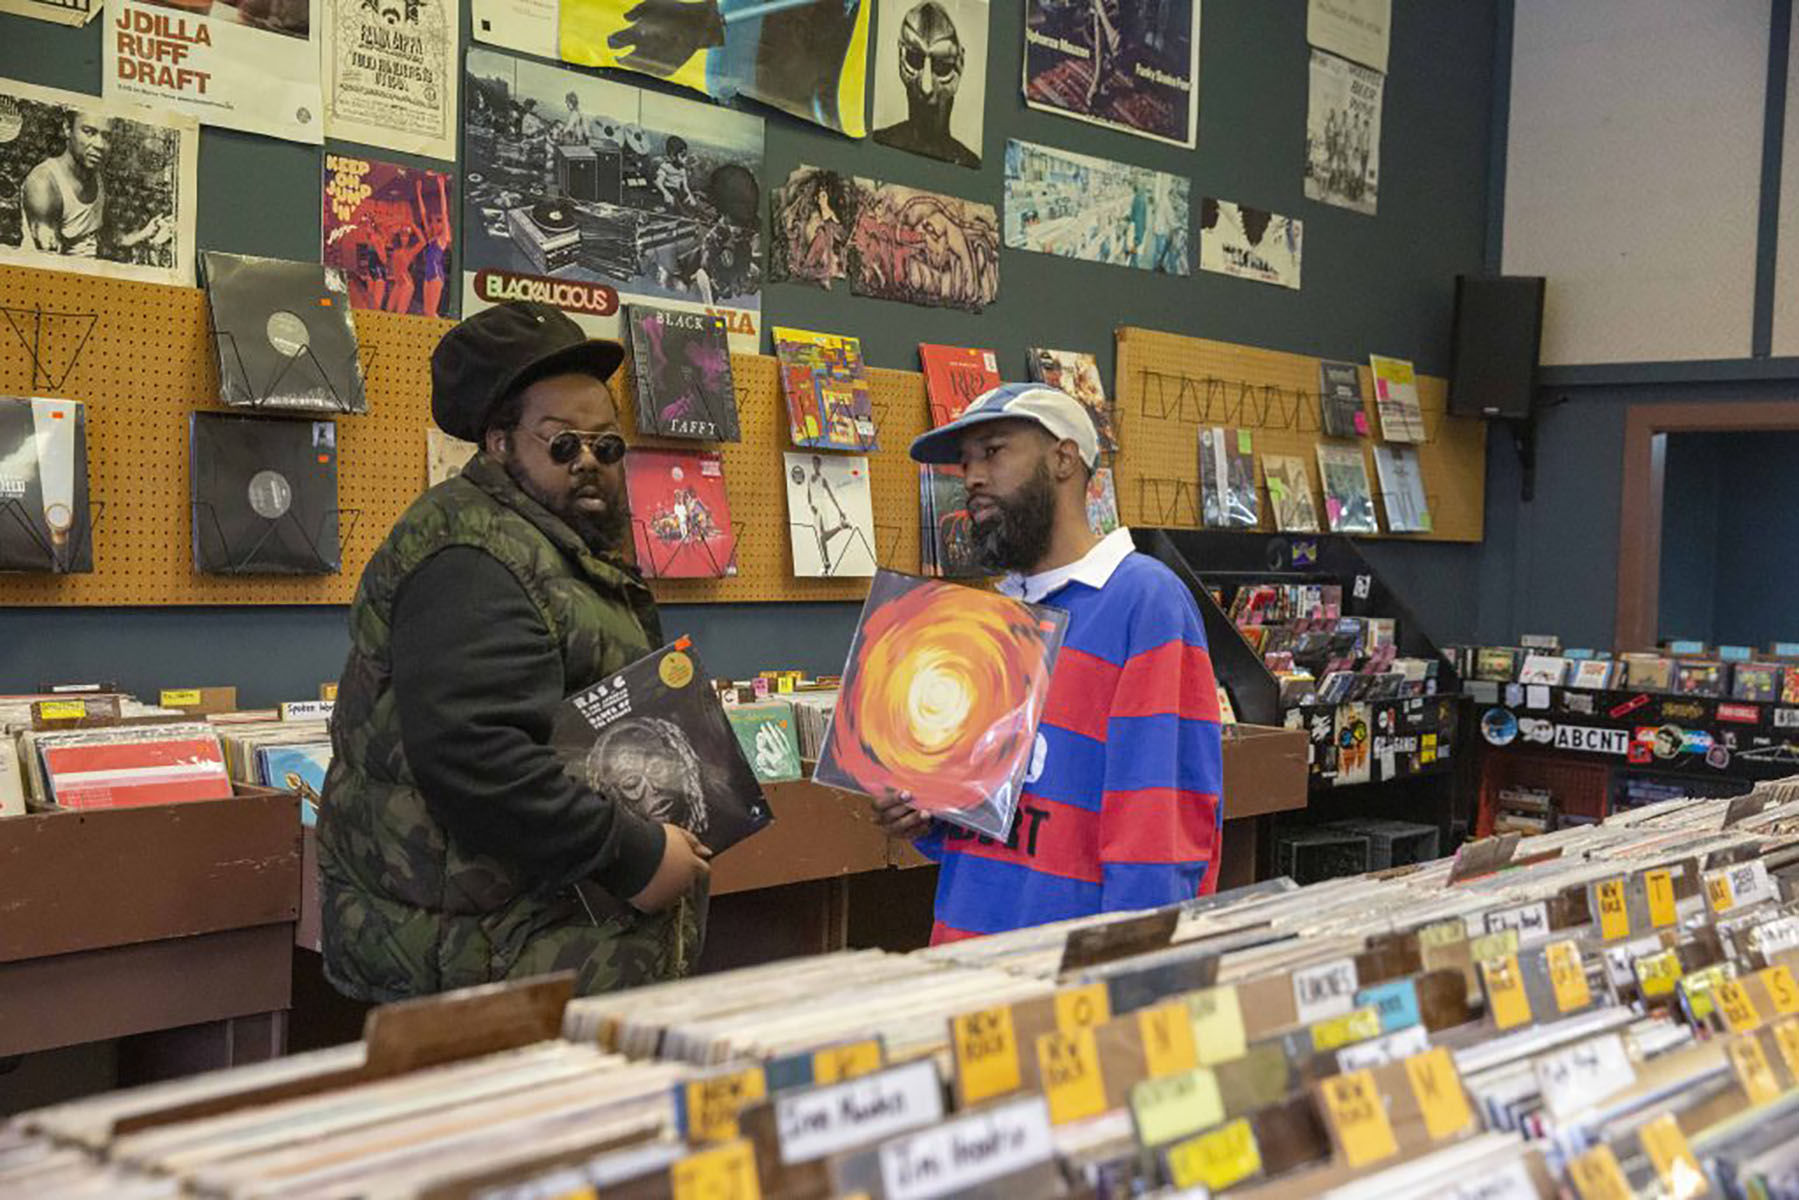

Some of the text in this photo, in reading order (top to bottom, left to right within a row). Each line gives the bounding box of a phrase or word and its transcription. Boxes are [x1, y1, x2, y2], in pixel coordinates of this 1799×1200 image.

[117, 31, 189, 65] RUFF
[117, 56, 211, 94] DRAFT
[486, 275, 608, 310] BLACKALICIOUS
[656, 311, 705, 331] BLACK
[670, 418, 718, 436] TAFFY
[1557, 728, 1627, 752] ABCNT
